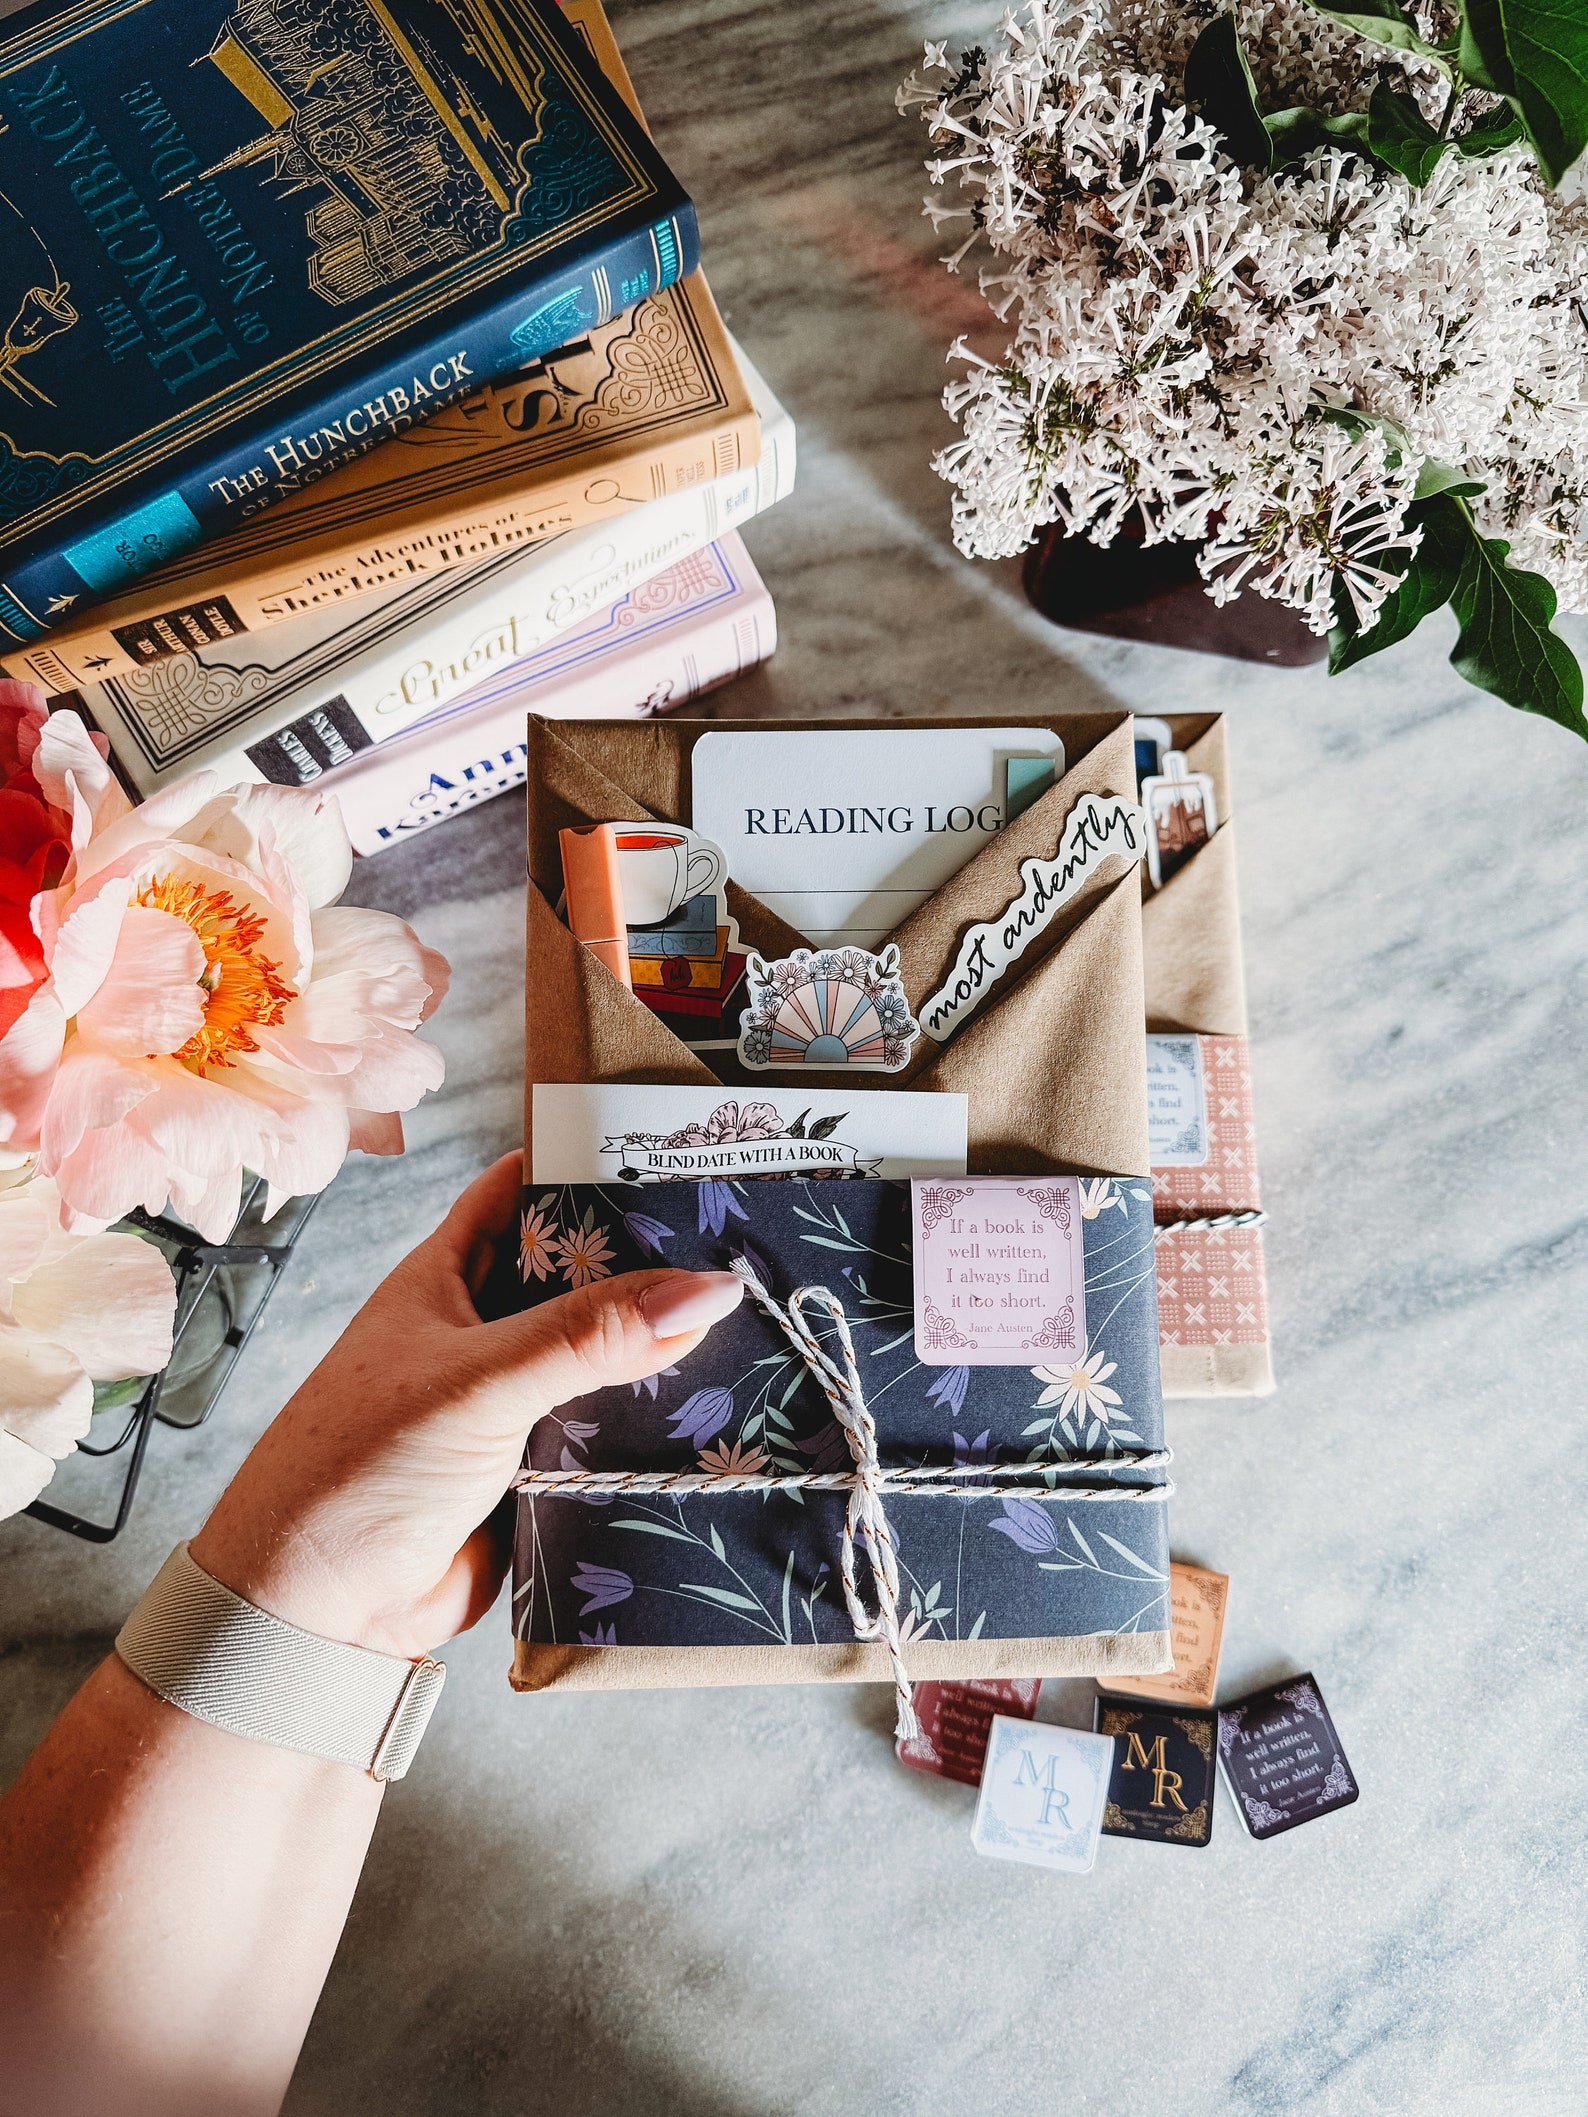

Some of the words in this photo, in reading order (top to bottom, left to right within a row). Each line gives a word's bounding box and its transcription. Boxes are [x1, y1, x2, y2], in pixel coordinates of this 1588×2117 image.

[8, 64, 241, 396] HUNCHBACK
[97, 297, 146, 364] THE
[233, 311, 270, 344] OF
[208, 466, 270, 505] THE
[264, 350, 474, 479] HUNCHBACK
[302, 567, 347, 586] The
[356, 522, 489, 569] Adventures
[495, 512, 520, 527] of
[261, 559, 429, 620] Sherlock
[439, 513, 574, 564] Holmes
[179, 613, 209, 644] CONAN
[204, 606, 234, 636] DOYLE
[136, 638, 157, 654] SIR
[375, 614, 540, 716] Great
[410, 743, 528, 808] Ann
[744, 806, 914, 835] READING
[924, 806, 1004, 834] LOG
[929, 934, 995, 1030] most
[1003, 804, 1136, 950] ardently
[647, 1153, 695, 1169] BLIND
[698, 1152, 737, 1168] DATE
[739, 1147, 782, 1164] WITH
[785, 1147, 796, 1160] A
[800, 1146, 844, 1162] BOOK
[949, 1218, 964, 1234] If
[969, 1224, 978, 1234] a
[985, 1218, 1025, 1234] book
[1032, 1220, 1044, 1234] is
[948, 1243, 980, 1259] well
[986, 1245, 1047, 1260] written,
[946, 1268, 953, 1283] I
[960, 1268, 1011, 1285] always
[1017, 1268, 1050, 1283] find
[951, 1294, 961, 1308] it
[969, 1293, 994, 1308] too
[1000, 1293, 1046, 1308] short.
[968, 1323, 993, 1333] Jane
[996, 1322, 1033, 1333] Austen
[1239, 1730, 1252, 1744] If
[1260, 1713, 1292, 1735] book
[1292, 1710, 1304, 1723] is
[1012, 1749, 1059, 1785] M
[1121, 1732, 1168, 1770] M
[1243, 1742, 1269, 1762] well
[1257, 1752, 1296, 1776] always
[1294, 1740, 1320, 1760] find
[1149, 1768, 1188, 1812] R
[1269, 1774, 1290, 1790] too
[1289, 1760, 1324, 1781] short.
[1037, 1787, 1073, 1830] R
